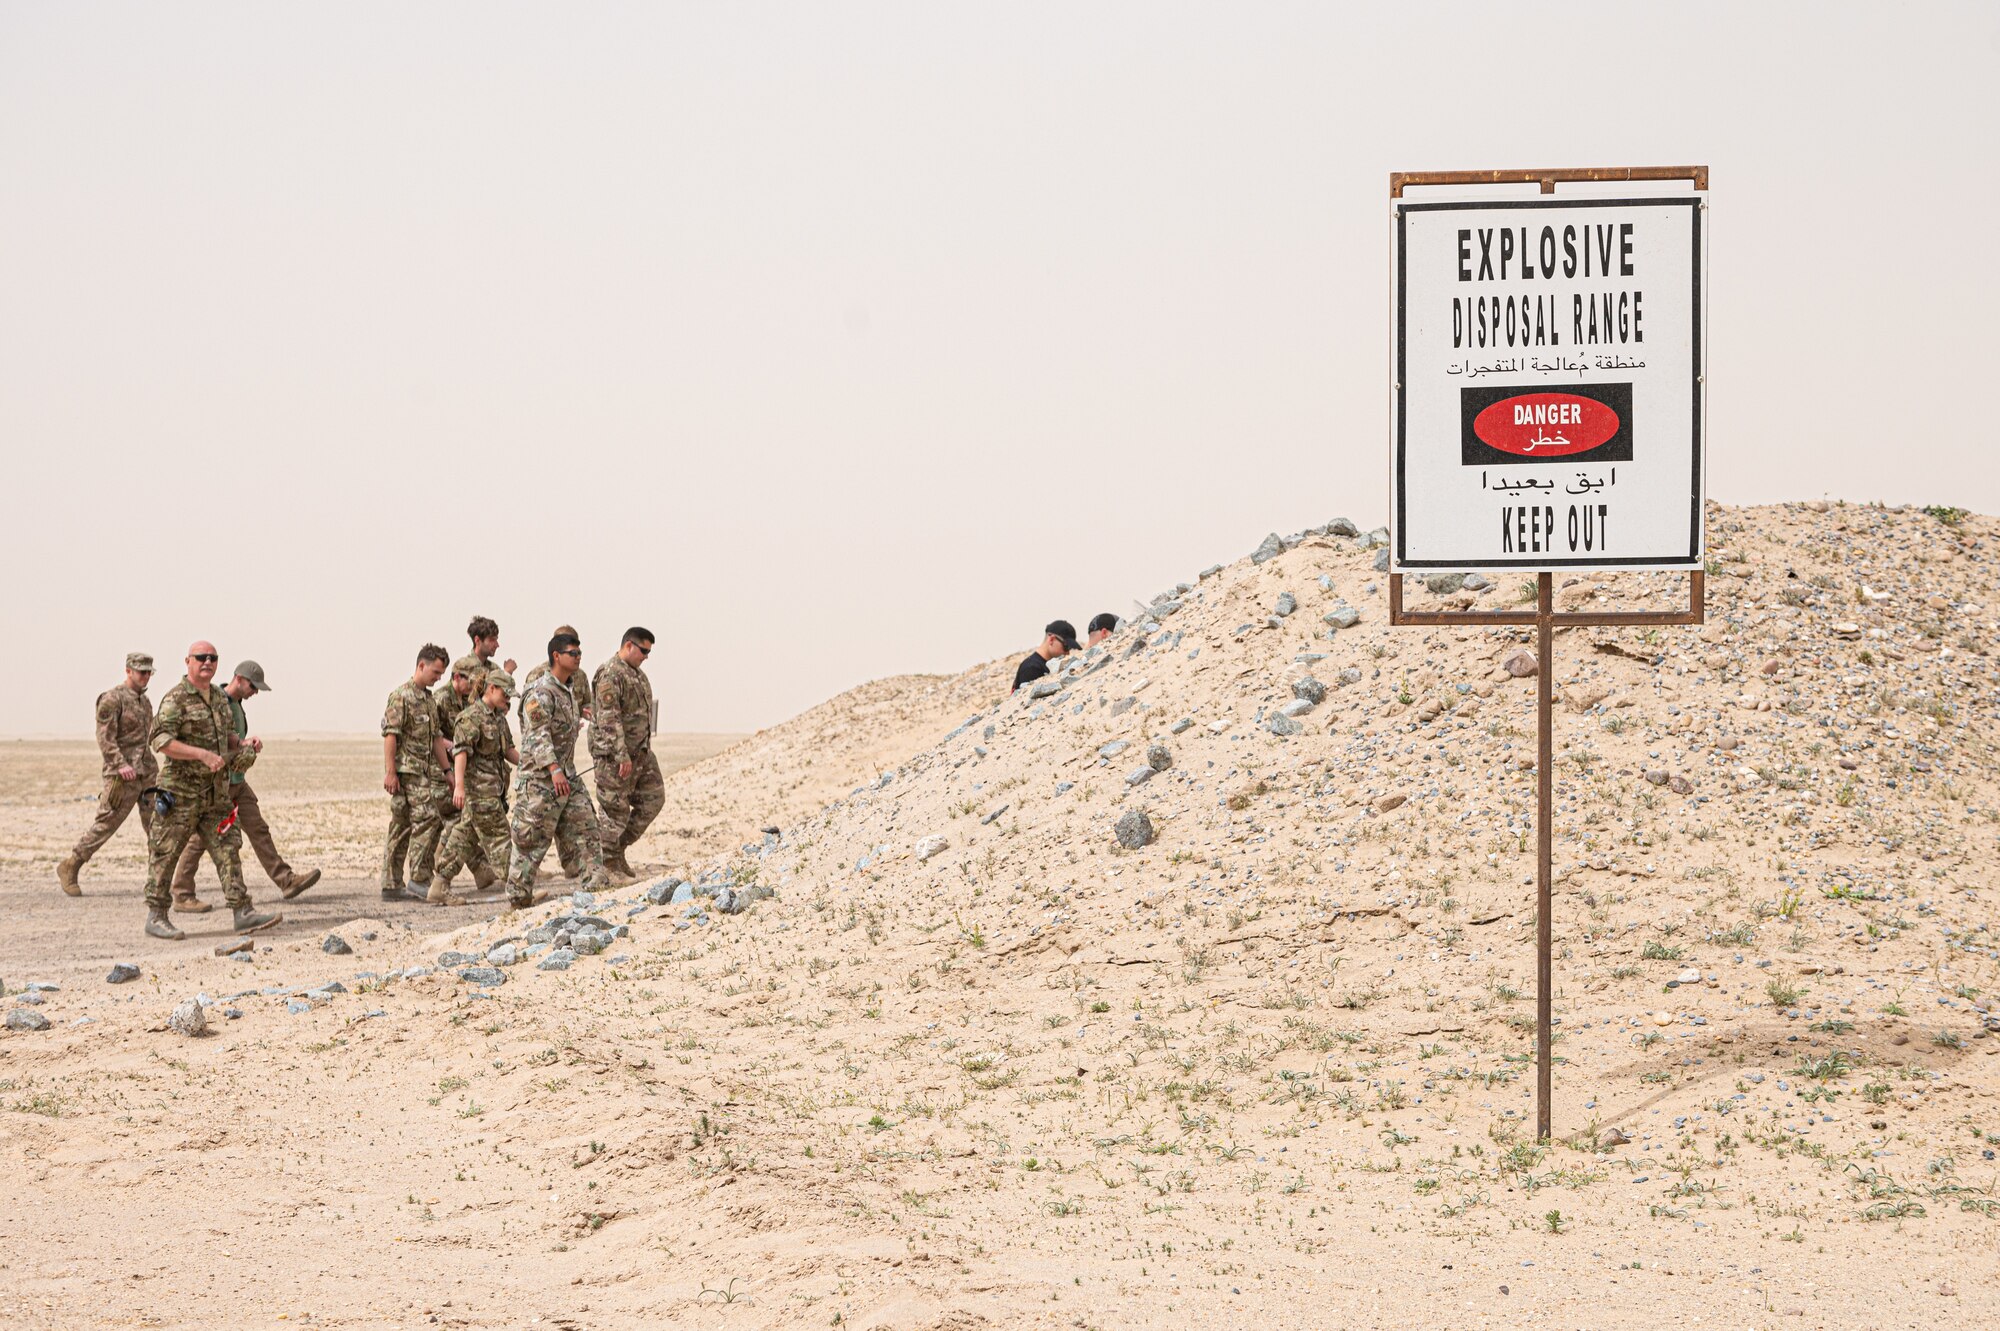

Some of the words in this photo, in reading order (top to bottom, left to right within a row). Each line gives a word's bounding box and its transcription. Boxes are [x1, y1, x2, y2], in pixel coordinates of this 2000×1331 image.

[1457, 223, 1634, 281] EXPLOSIVE
[1453, 294, 1559, 348] DISPOSAL
[1573, 291, 1642, 345] RANGE
[1446, 357, 1524, 378] المتفجرات
[1595, 355, 1646, 370] منطقة
[1514, 403, 1582, 425] DANGER
[1522, 427, 1571, 452] خطر
[1482, 470, 1555, 497] بعيدا
[1565, 467, 1616, 495] ابق
[1502, 505, 1554, 553] KEEP
[1567, 504, 1608, 552] OUT
